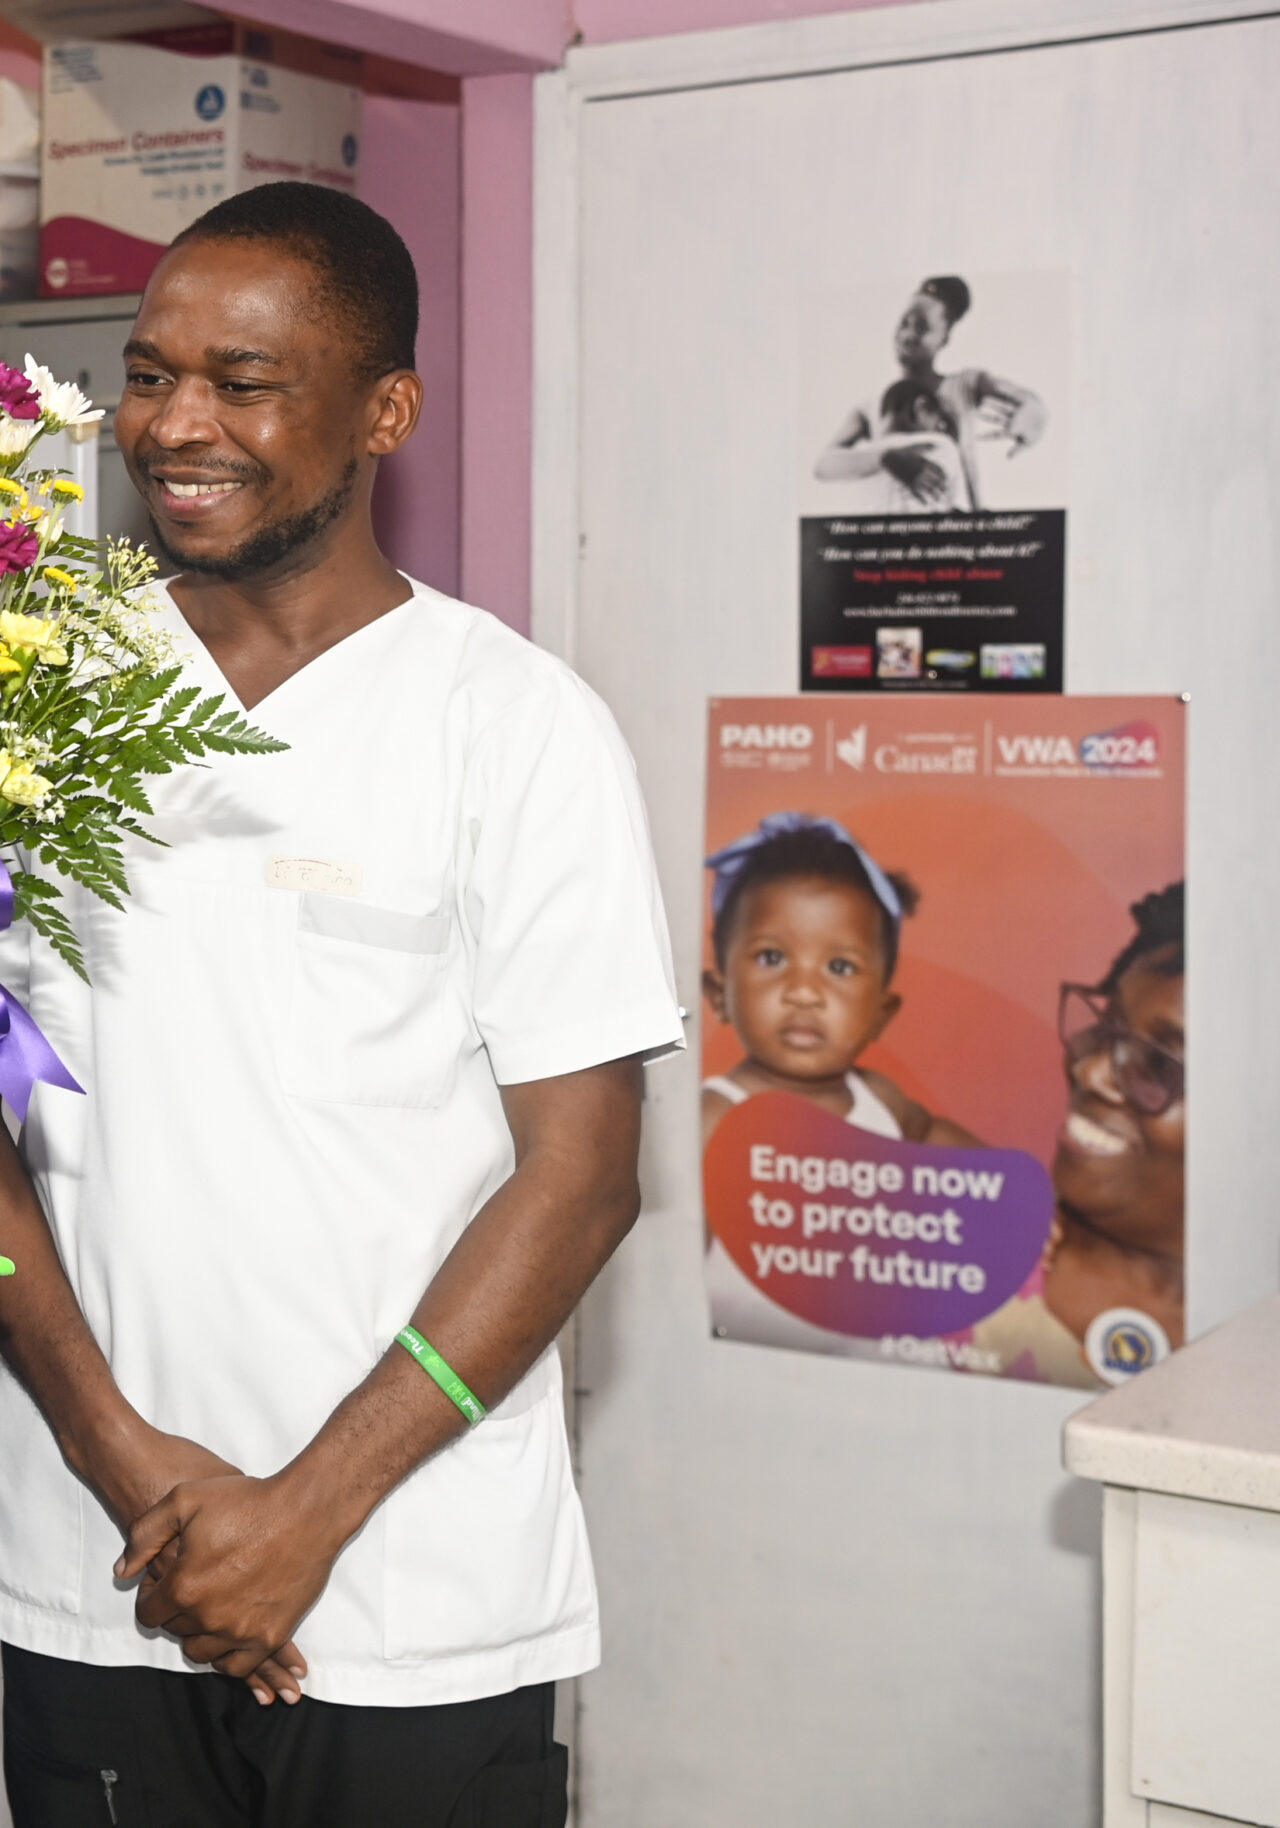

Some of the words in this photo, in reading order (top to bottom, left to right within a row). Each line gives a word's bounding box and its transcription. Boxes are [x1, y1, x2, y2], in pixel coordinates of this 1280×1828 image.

[48, 136, 126, 161] Specimen
[131, 128, 225, 153] Containers
[720, 724, 813, 748] PAHO
[997, 736, 1077, 765] VWA
[1081, 735, 1157, 764] 2024
[749, 1144, 904, 1198] Engage
[912, 1162, 1005, 1201] now
[749, 1191, 795, 1228] to
[802, 1194, 964, 1245] protect
[750, 1240, 844, 1279] your
[849, 1245, 986, 1294] future
[879, 1334, 1001, 1374] #GetVax
